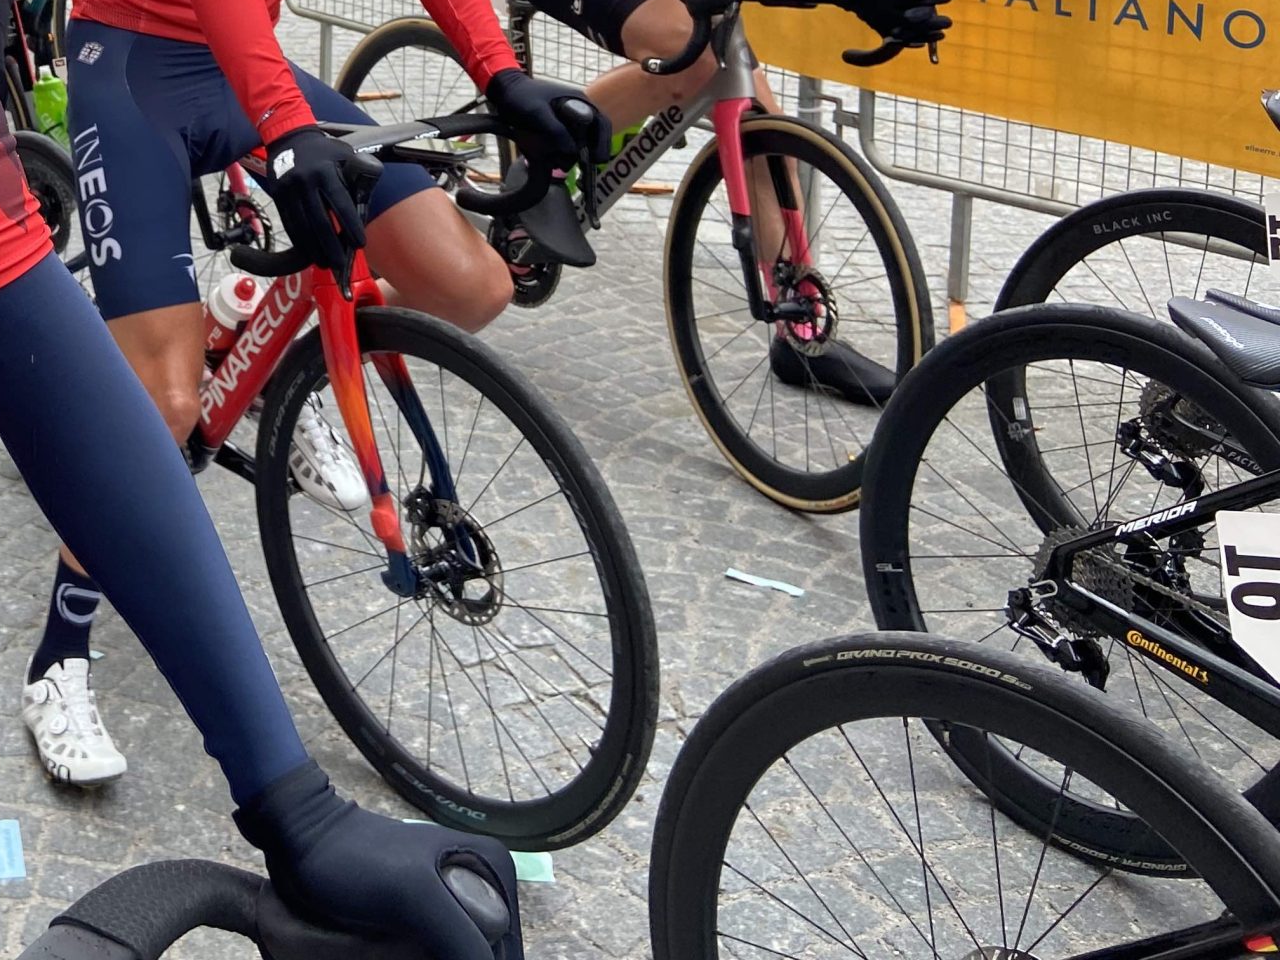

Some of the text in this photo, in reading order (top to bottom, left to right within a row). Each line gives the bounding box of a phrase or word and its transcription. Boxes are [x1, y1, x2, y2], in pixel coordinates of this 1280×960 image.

[73, 123, 122, 268] INEOS
[1093, 210, 1173, 235] BLACK INC
[199, 272, 304, 425] PINARELLO
[1115, 501, 1198, 536] MERIDA
[837, 649, 896, 660] GRAND
[896, 650, 943, 664] PRIX
[944, 658, 1001, 678] 5000
[1127, 630, 1200, 680] Continental
